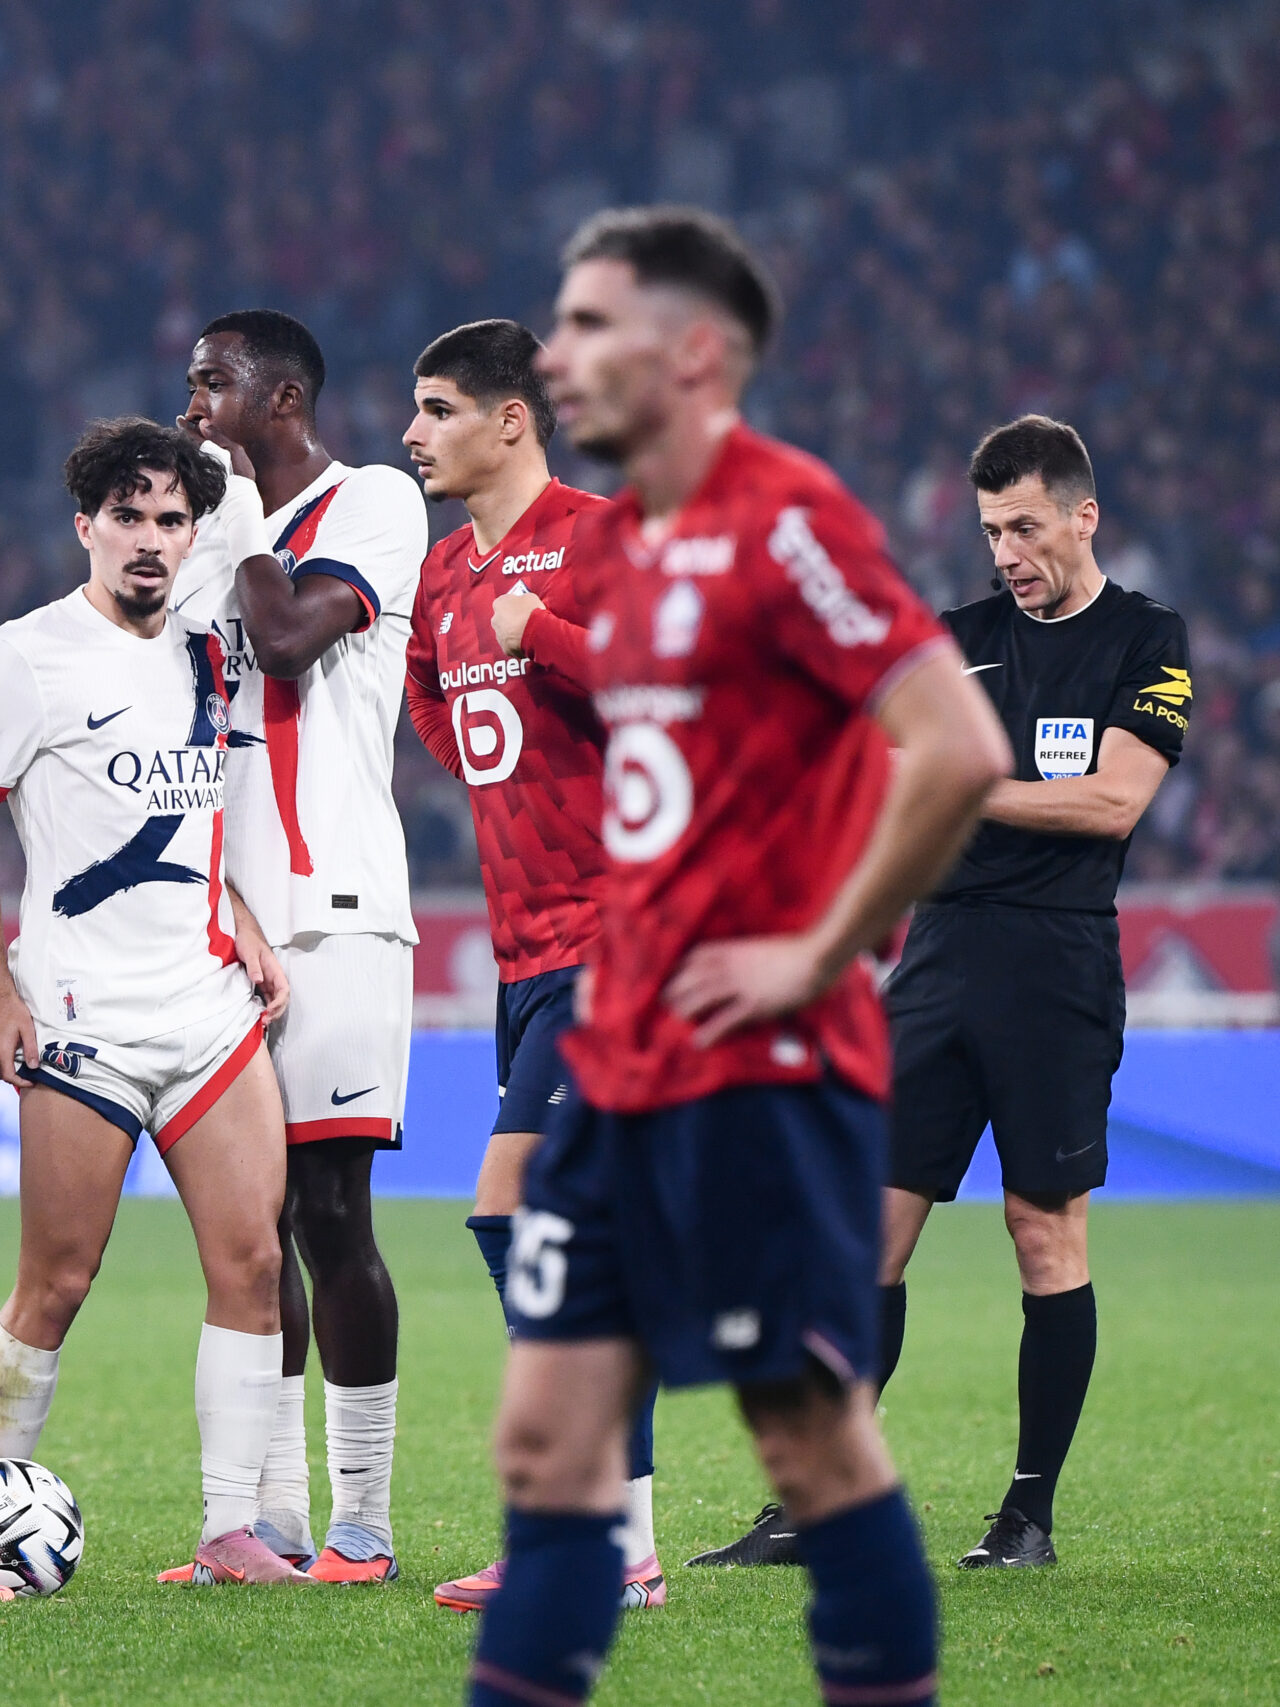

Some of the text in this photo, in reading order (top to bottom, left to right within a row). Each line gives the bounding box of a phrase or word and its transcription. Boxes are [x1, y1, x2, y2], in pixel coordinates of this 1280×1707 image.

[502, 546, 566, 575] actual
[439, 657, 531, 691] oulanger
[1041, 723, 1088, 740] FIFA
[1133, 698, 1189, 736] LA POST
[1039, 750, 1088, 761] REFEREE
